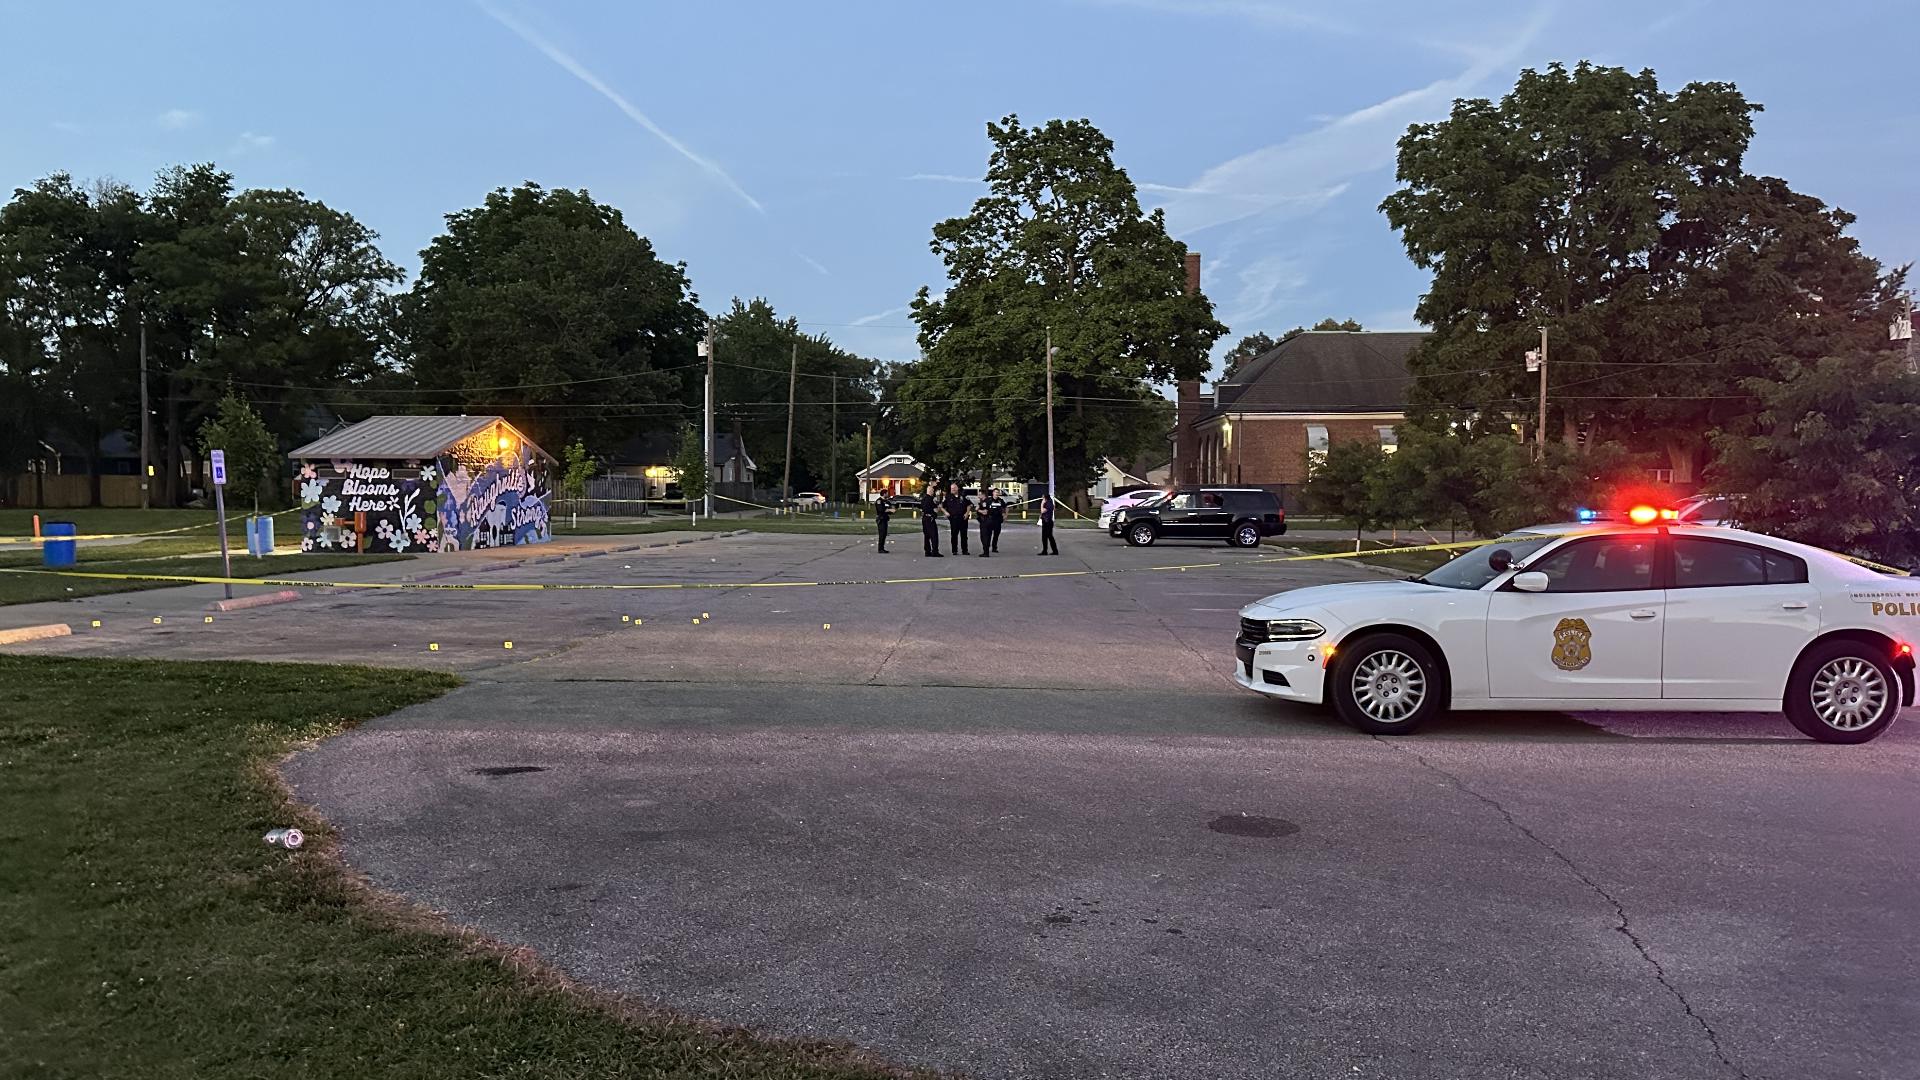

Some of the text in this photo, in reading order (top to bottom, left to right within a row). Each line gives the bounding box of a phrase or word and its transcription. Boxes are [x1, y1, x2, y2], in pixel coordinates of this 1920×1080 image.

[349, 463, 390, 484] Hope
[342, 479, 399, 495] Blooms
[348, 496, 388, 512] Here
[510, 504, 549, 537] Strong
[1872, 602, 1920, 616] POLI
